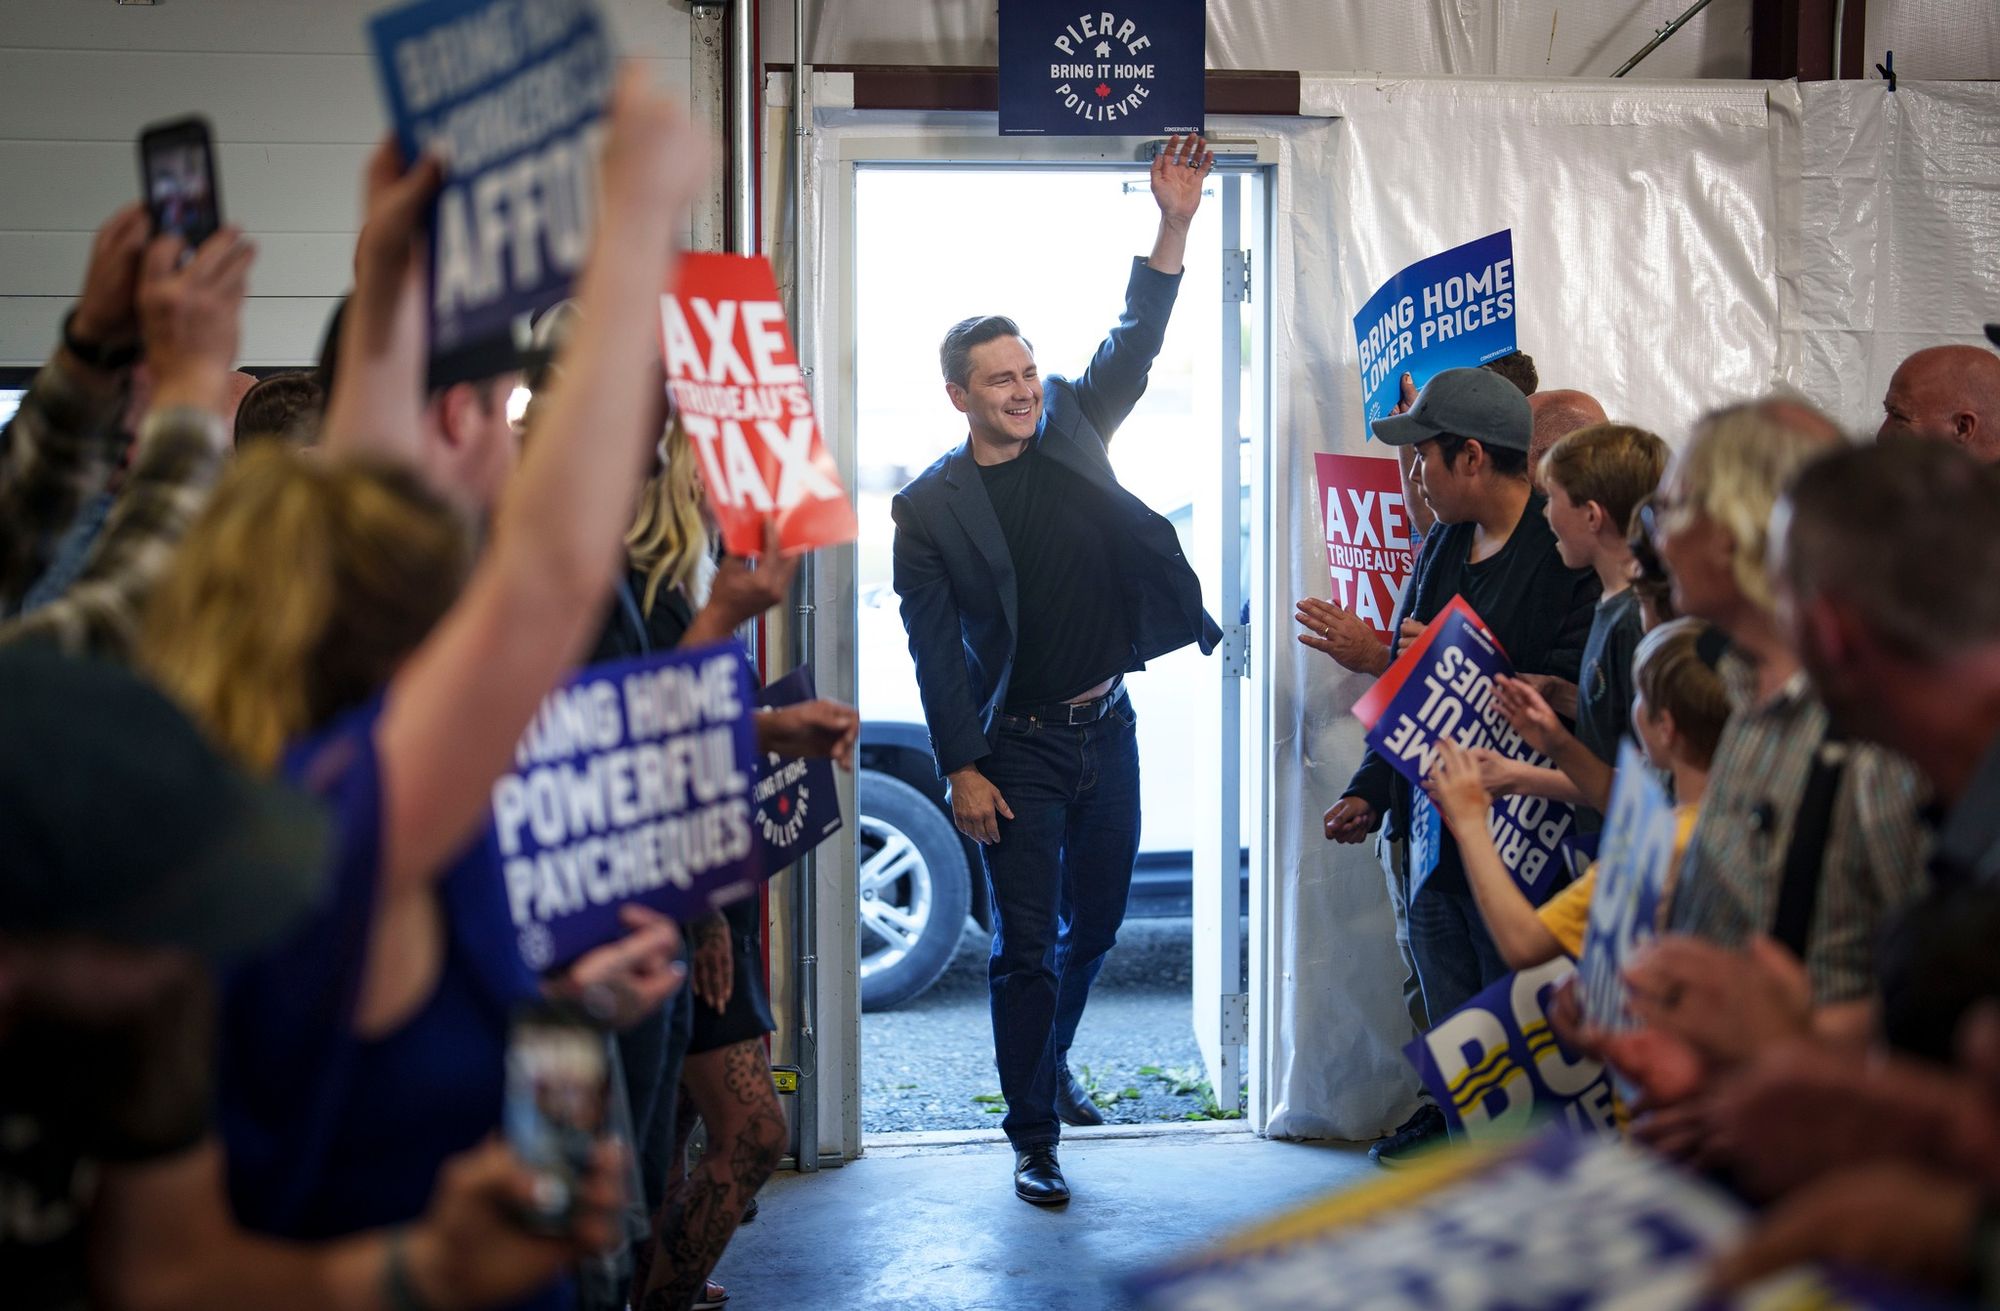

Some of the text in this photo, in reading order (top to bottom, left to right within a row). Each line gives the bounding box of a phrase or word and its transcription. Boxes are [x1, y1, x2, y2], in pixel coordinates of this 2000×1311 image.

[1051, 65, 1155, 79] BRING IT HOME
[1054, 12, 1151, 56] PIERRE
[1055, 83, 1150, 122] POILIEVRE
[659, 293, 801, 385] AXE
[1359, 258, 1513, 375] BRING HOME
[1363, 292, 1513, 404] LOWER PRICES
[665, 379, 814, 421] TRUDEAU'S
[682, 415, 843, 512] TAX
[1326, 486, 1411, 550] AXE
[623, 653, 744, 742] HOME
[491, 726, 749, 856] POWERFUL
[754, 783, 810, 848] POILIEVRE
[503, 798, 752, 926] PAYCHEQUES
[1486, 807, 1549, 886] BRIN
